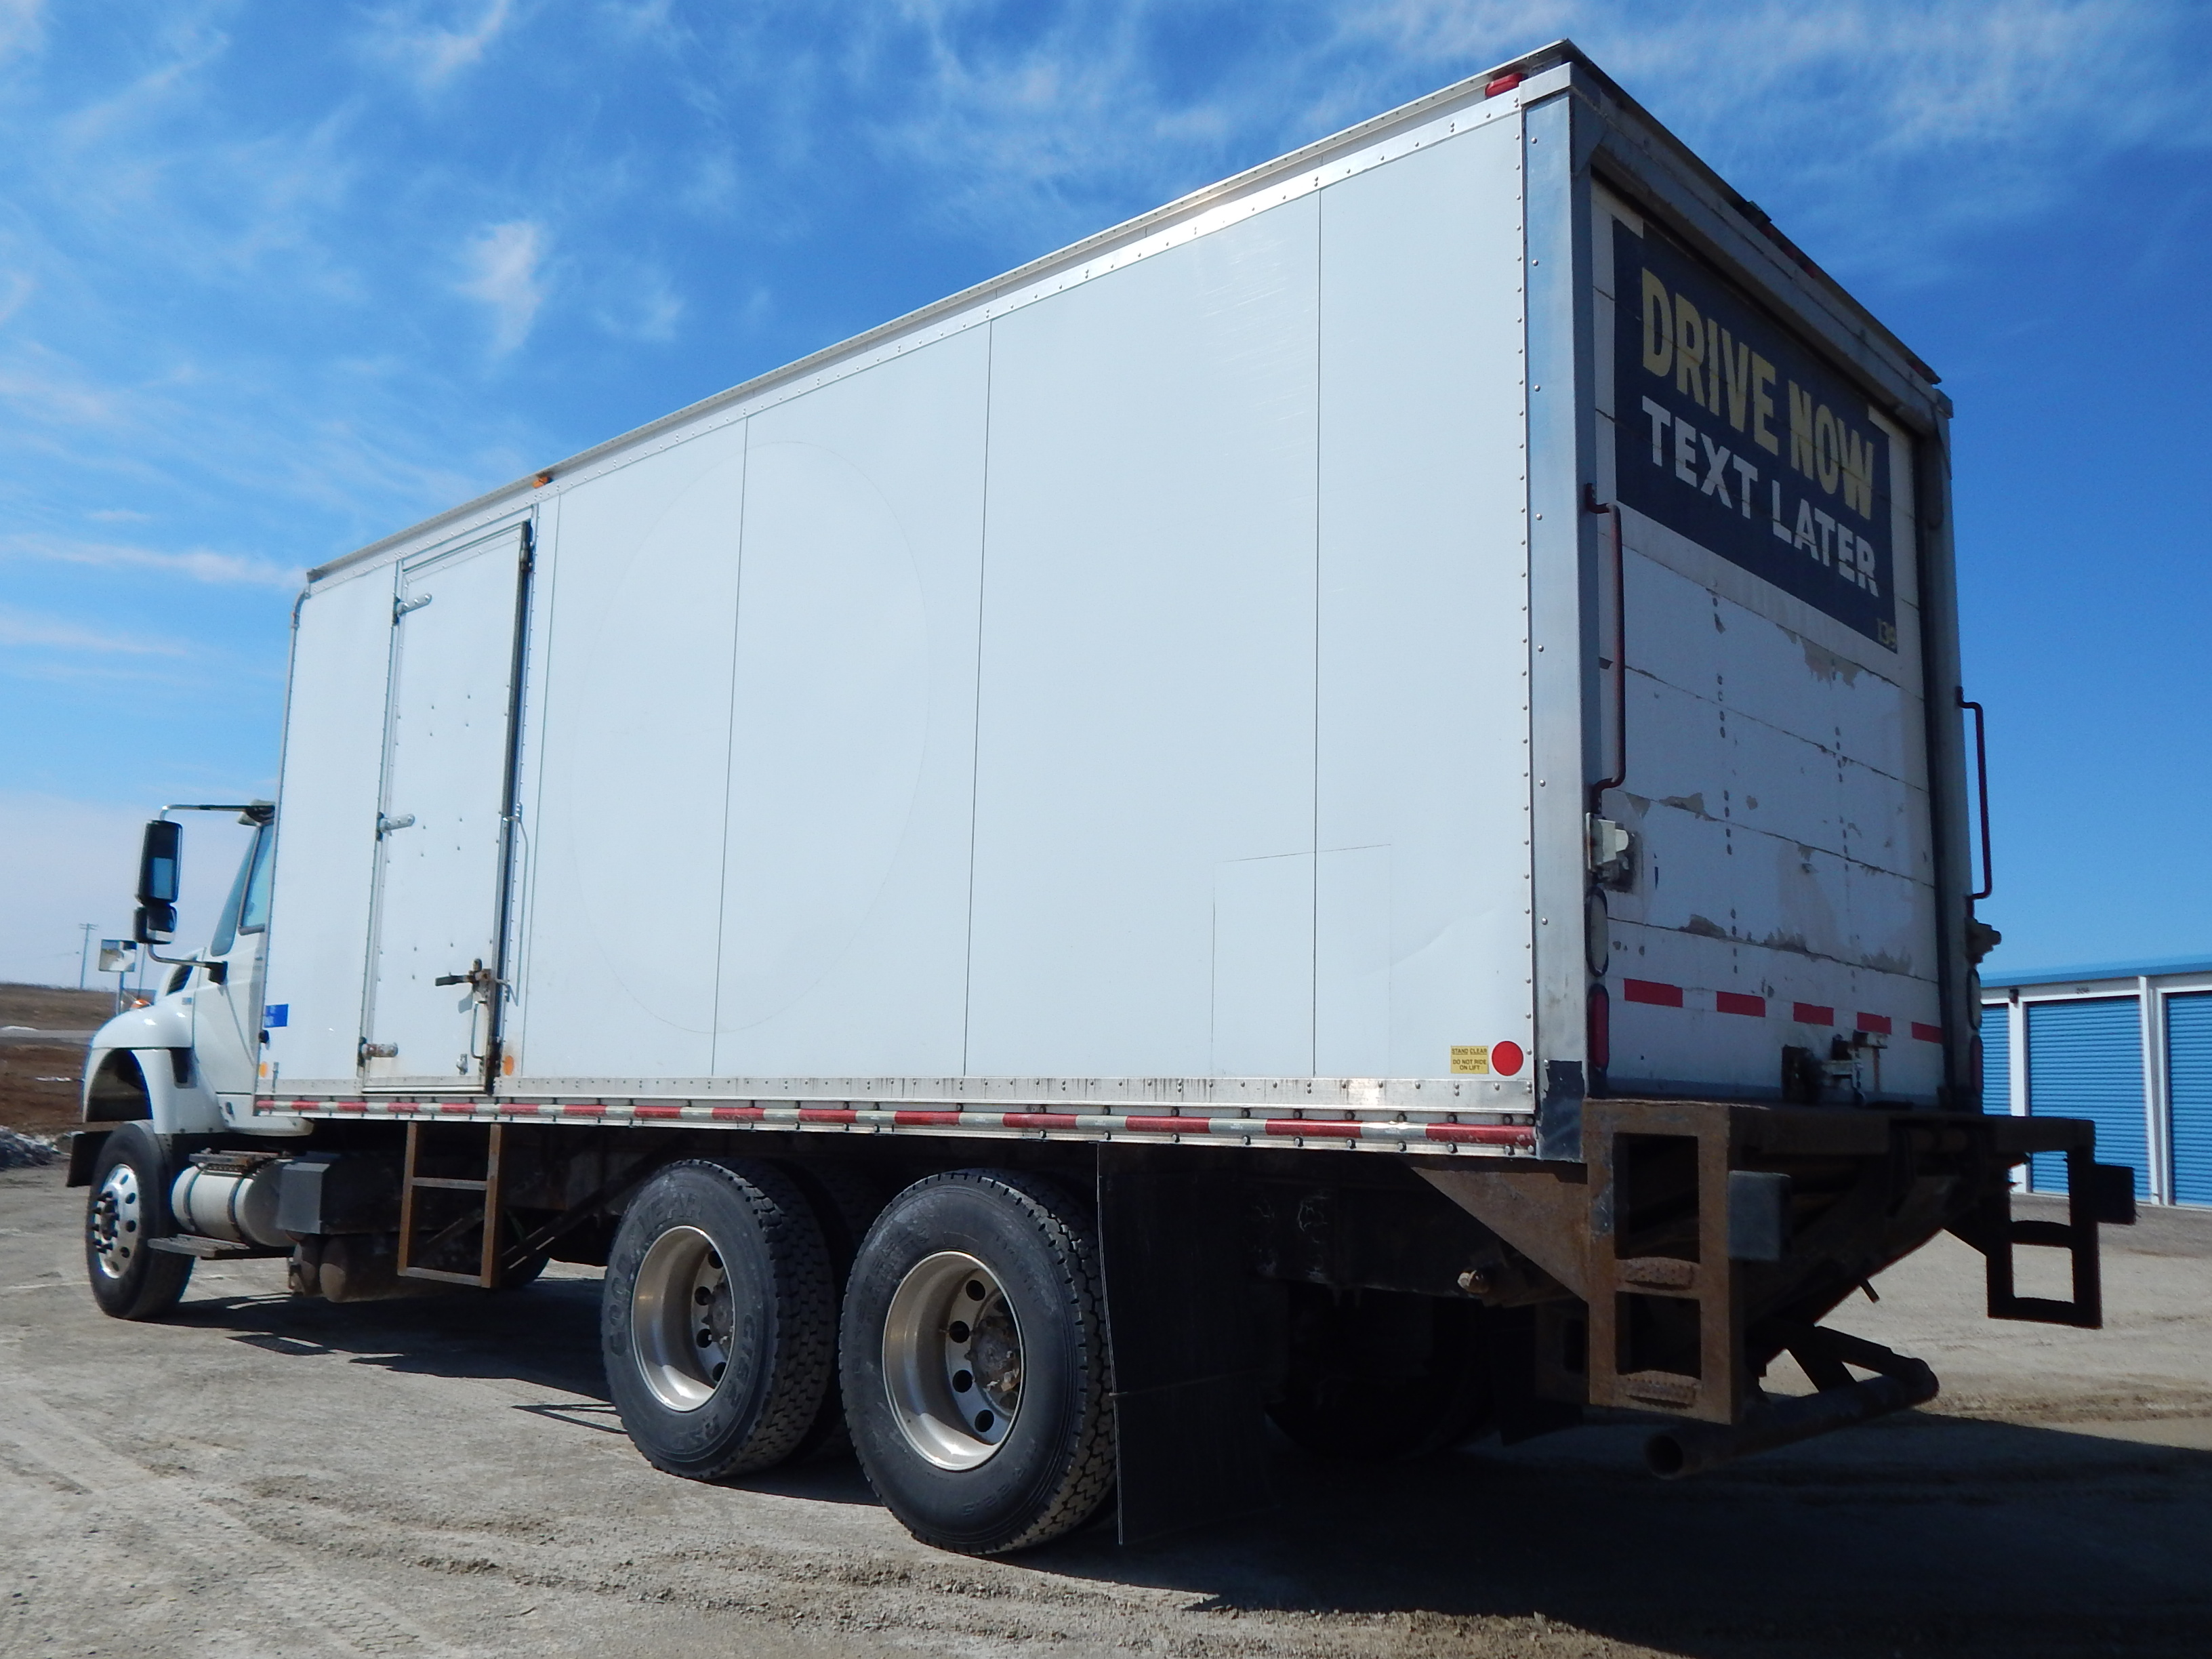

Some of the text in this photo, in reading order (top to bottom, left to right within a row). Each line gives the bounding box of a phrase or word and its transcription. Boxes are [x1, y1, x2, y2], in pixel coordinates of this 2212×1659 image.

[1642, 267, 1874, 520] DRIVE NOW
[1642, 395, 1879, 598] TEXT LATER
